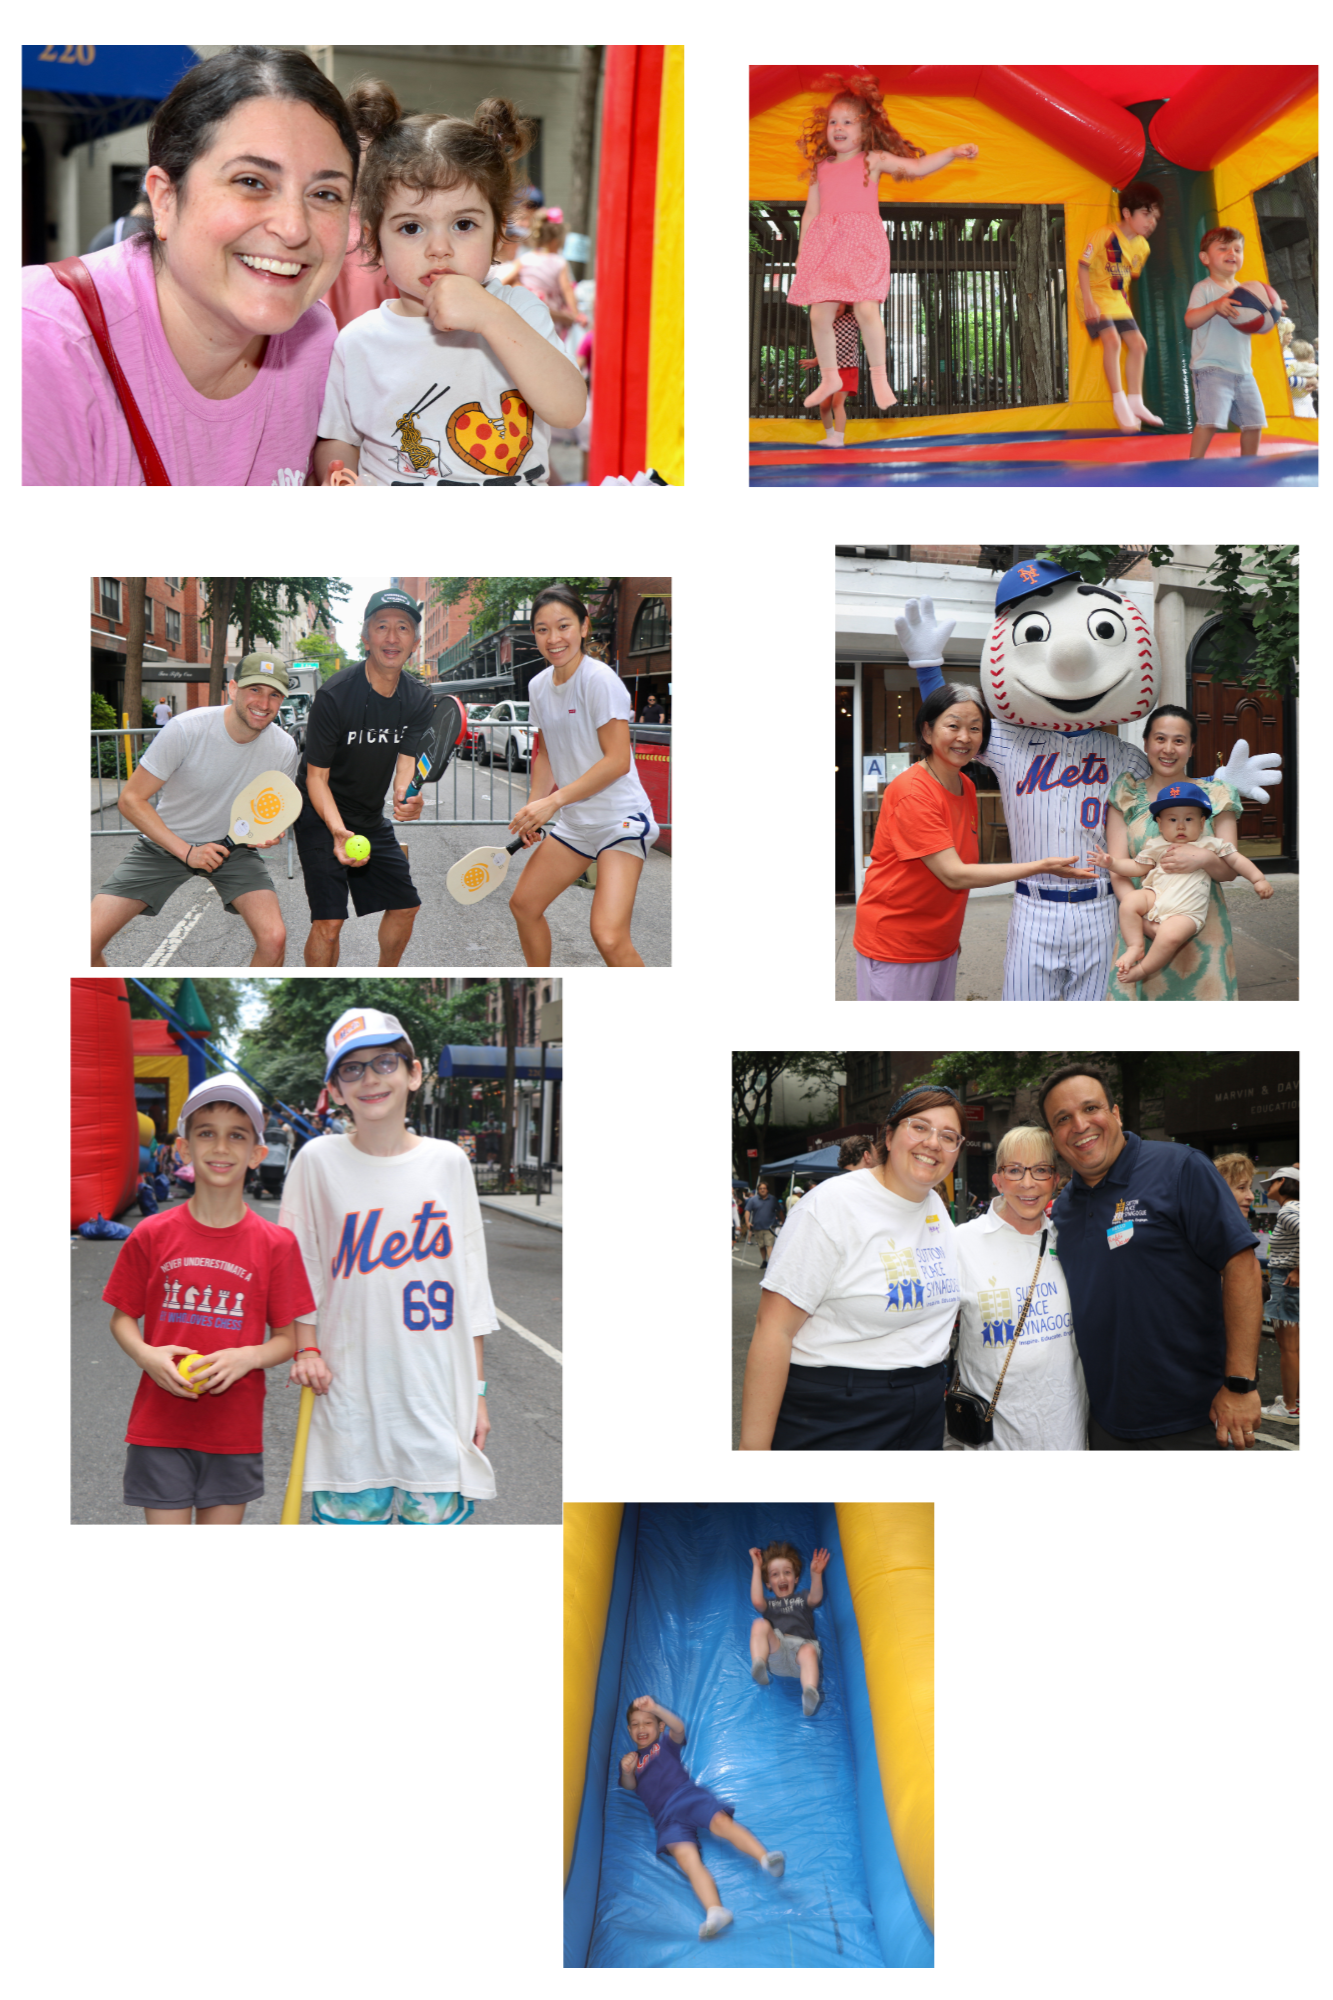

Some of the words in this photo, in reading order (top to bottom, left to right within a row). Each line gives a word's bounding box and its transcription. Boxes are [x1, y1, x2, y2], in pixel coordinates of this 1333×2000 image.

[868, 759, 882, 775] A
[1016, 752, 1109, 796] Mets
[1214, 1088, 1254, 1102] MARVIN
[1261, 1085, 1269, 1096] &
[1251, 1100, 1299, 1114] EDUCATIO
[331, 1200, 454, 1281] Mets
[915, 1246, 946, 1263] SUTTON
[160, 1258, 182, 1273] NEVER
[183, 1257, 247, 1279] UNDERESTIMATE
[244, 1272, 253, 1282] A
[920, 1262, 947, 1279] PLACE
[1015, 1281, 1058, 1302] SUTON
[402, 1280, 454, 1331] 69
[1017, 1299, 1050, 1319] PACE
[214, 1317, 243, 1331] CHESS
